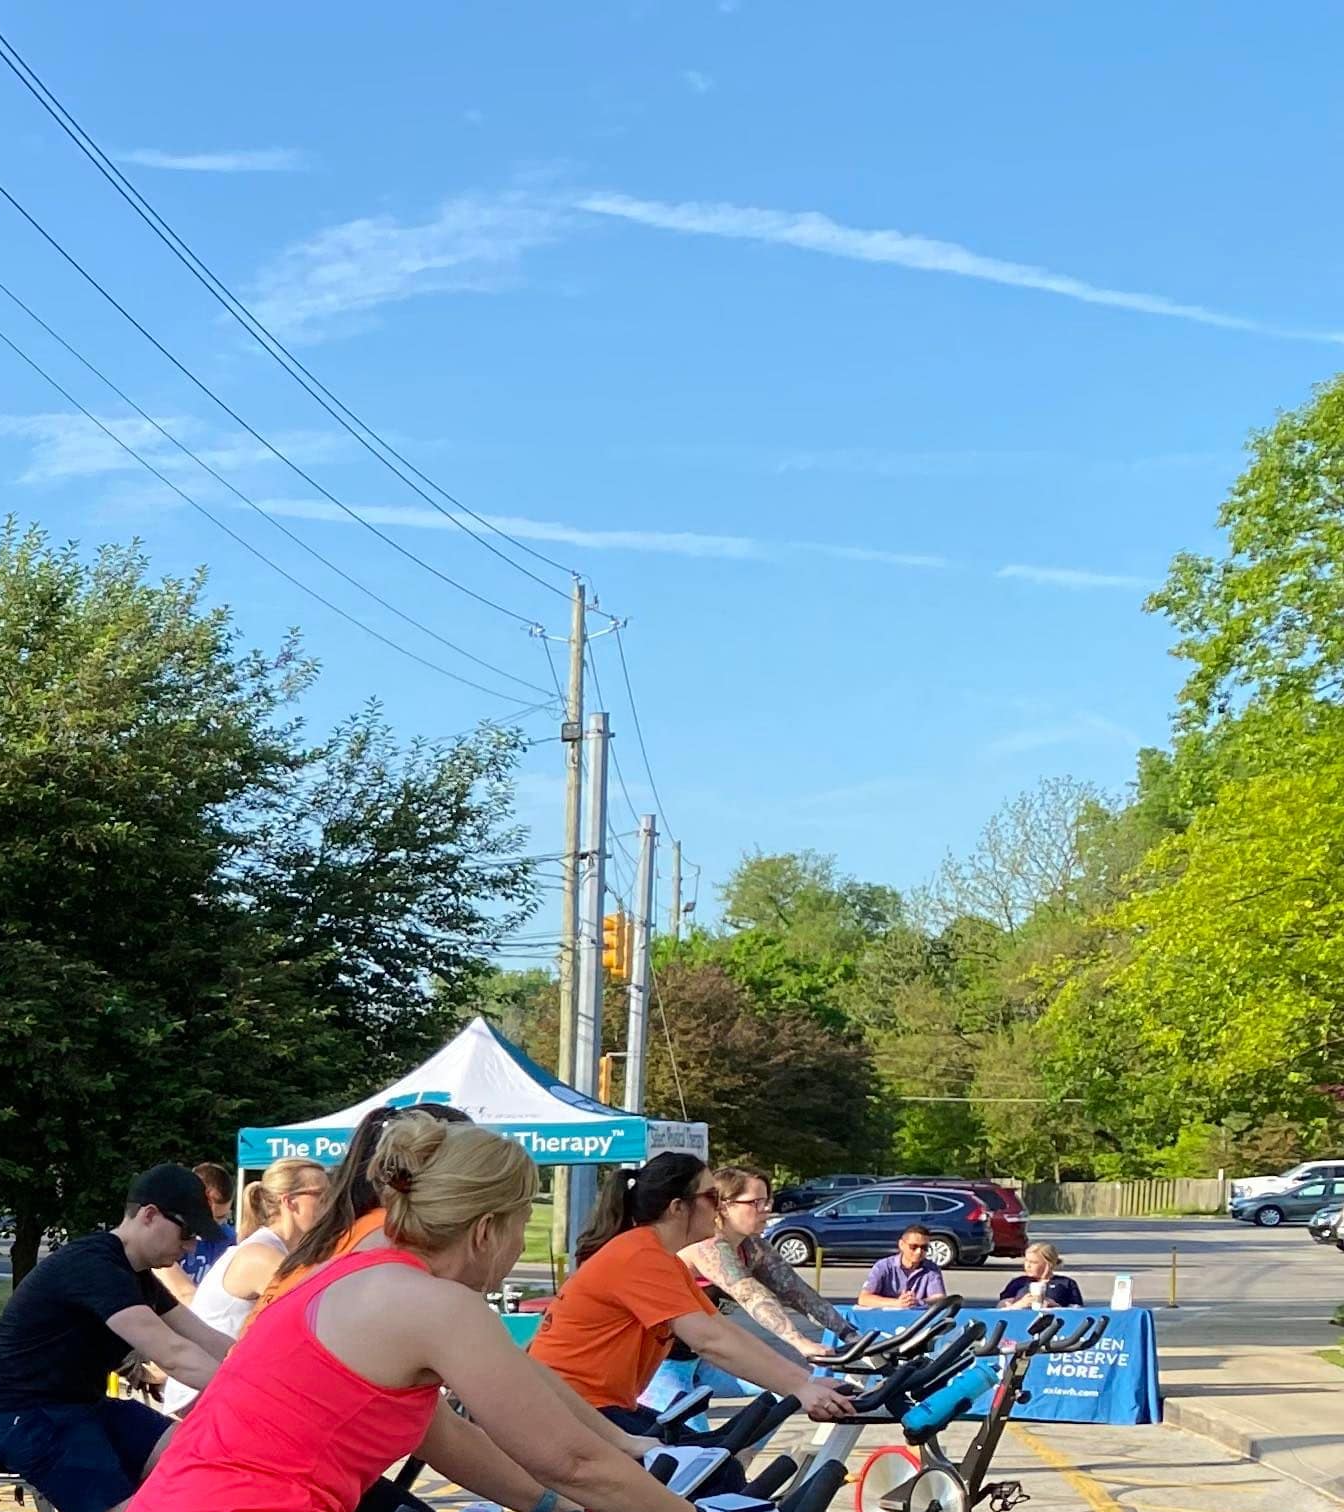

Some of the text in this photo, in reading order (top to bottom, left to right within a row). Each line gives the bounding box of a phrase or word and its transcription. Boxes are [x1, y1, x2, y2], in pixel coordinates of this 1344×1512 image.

[266, 1136, 348, 1157] The Po
[1050, 1350, 1130, 1367] DESERVE
[1046, 1363, 1105, 1379] MORE.
